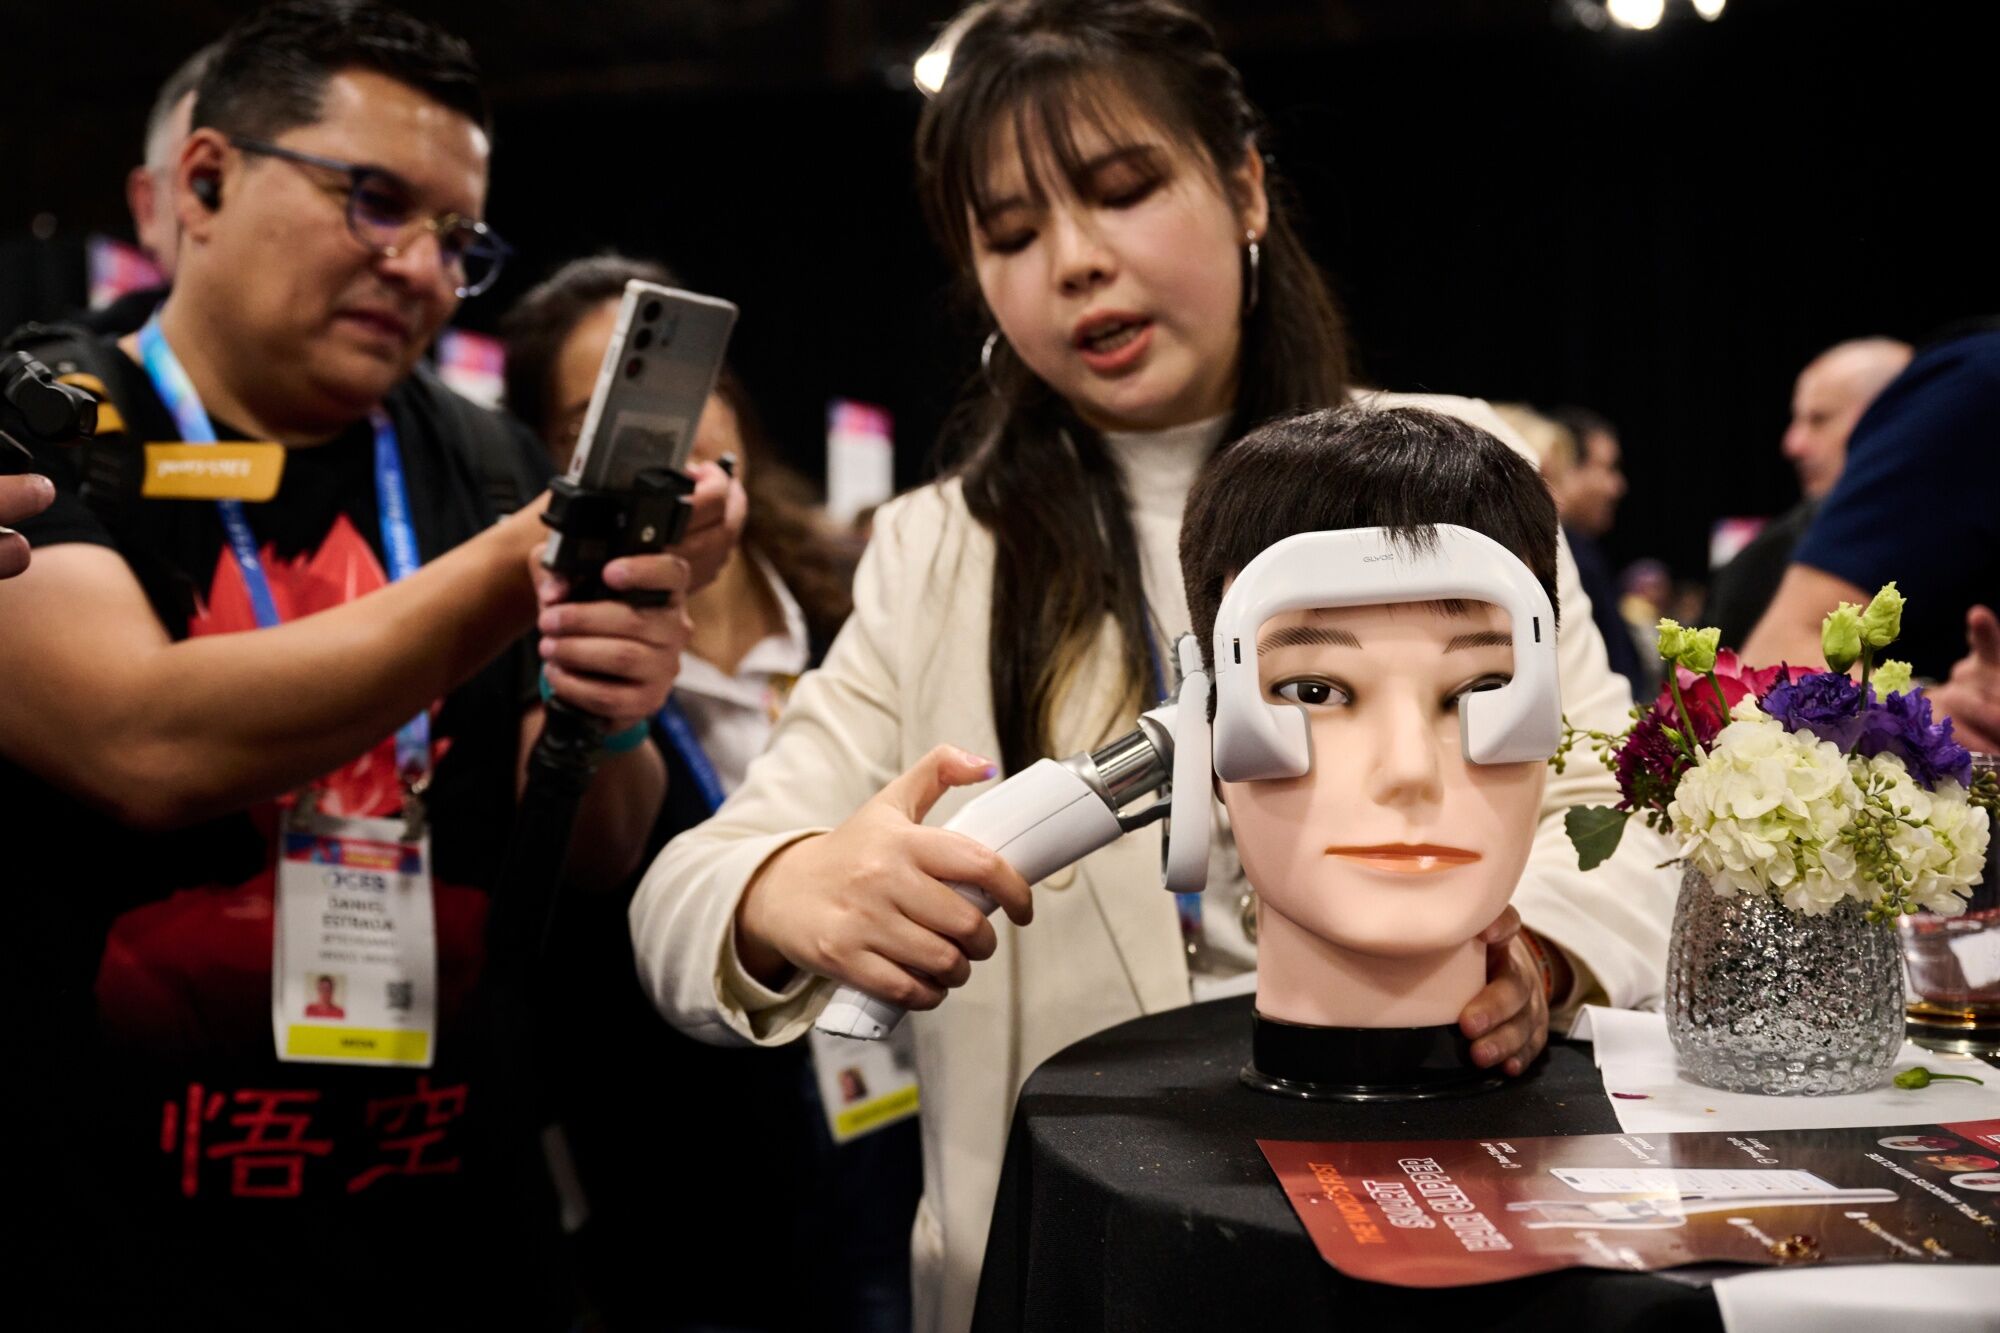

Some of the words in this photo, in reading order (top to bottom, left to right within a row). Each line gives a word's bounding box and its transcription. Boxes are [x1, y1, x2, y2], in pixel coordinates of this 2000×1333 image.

[160, 1075, 469, 1198] 悟空
[1362, 1179, 1437, 1229] SMART
[1398, 1157, 1476, 1213] CLIPPER
[1443, 1212, 1513, 1252] HAIR
